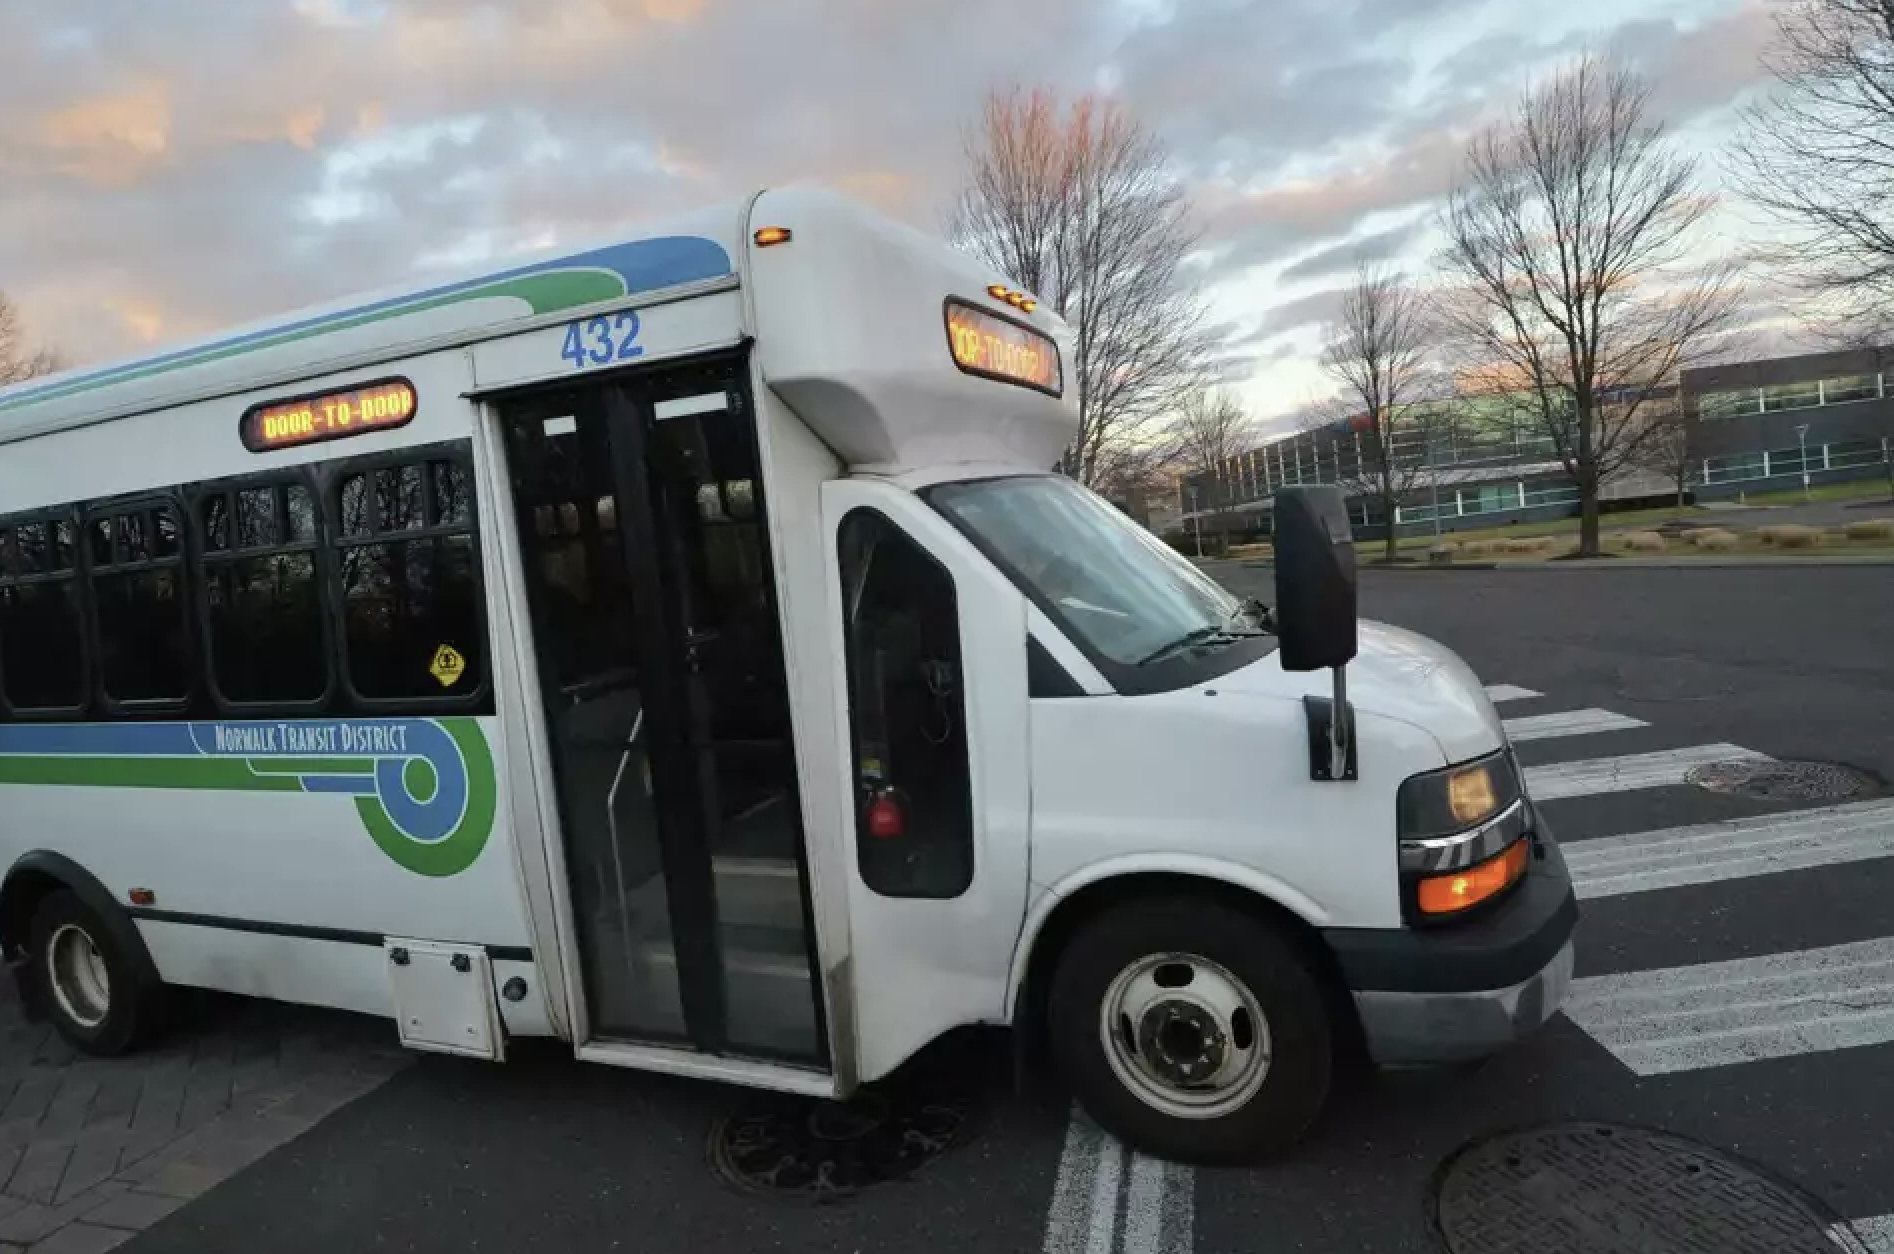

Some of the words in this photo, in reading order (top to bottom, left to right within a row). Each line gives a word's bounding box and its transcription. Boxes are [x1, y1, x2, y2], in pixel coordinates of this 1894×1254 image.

[562, 311, 643, 367] 432
[215, 724, 276, 751] NORWALK
[278, 723, 337, 752] TRANSIT
[342, 723, 407, 752] DISTRICT
